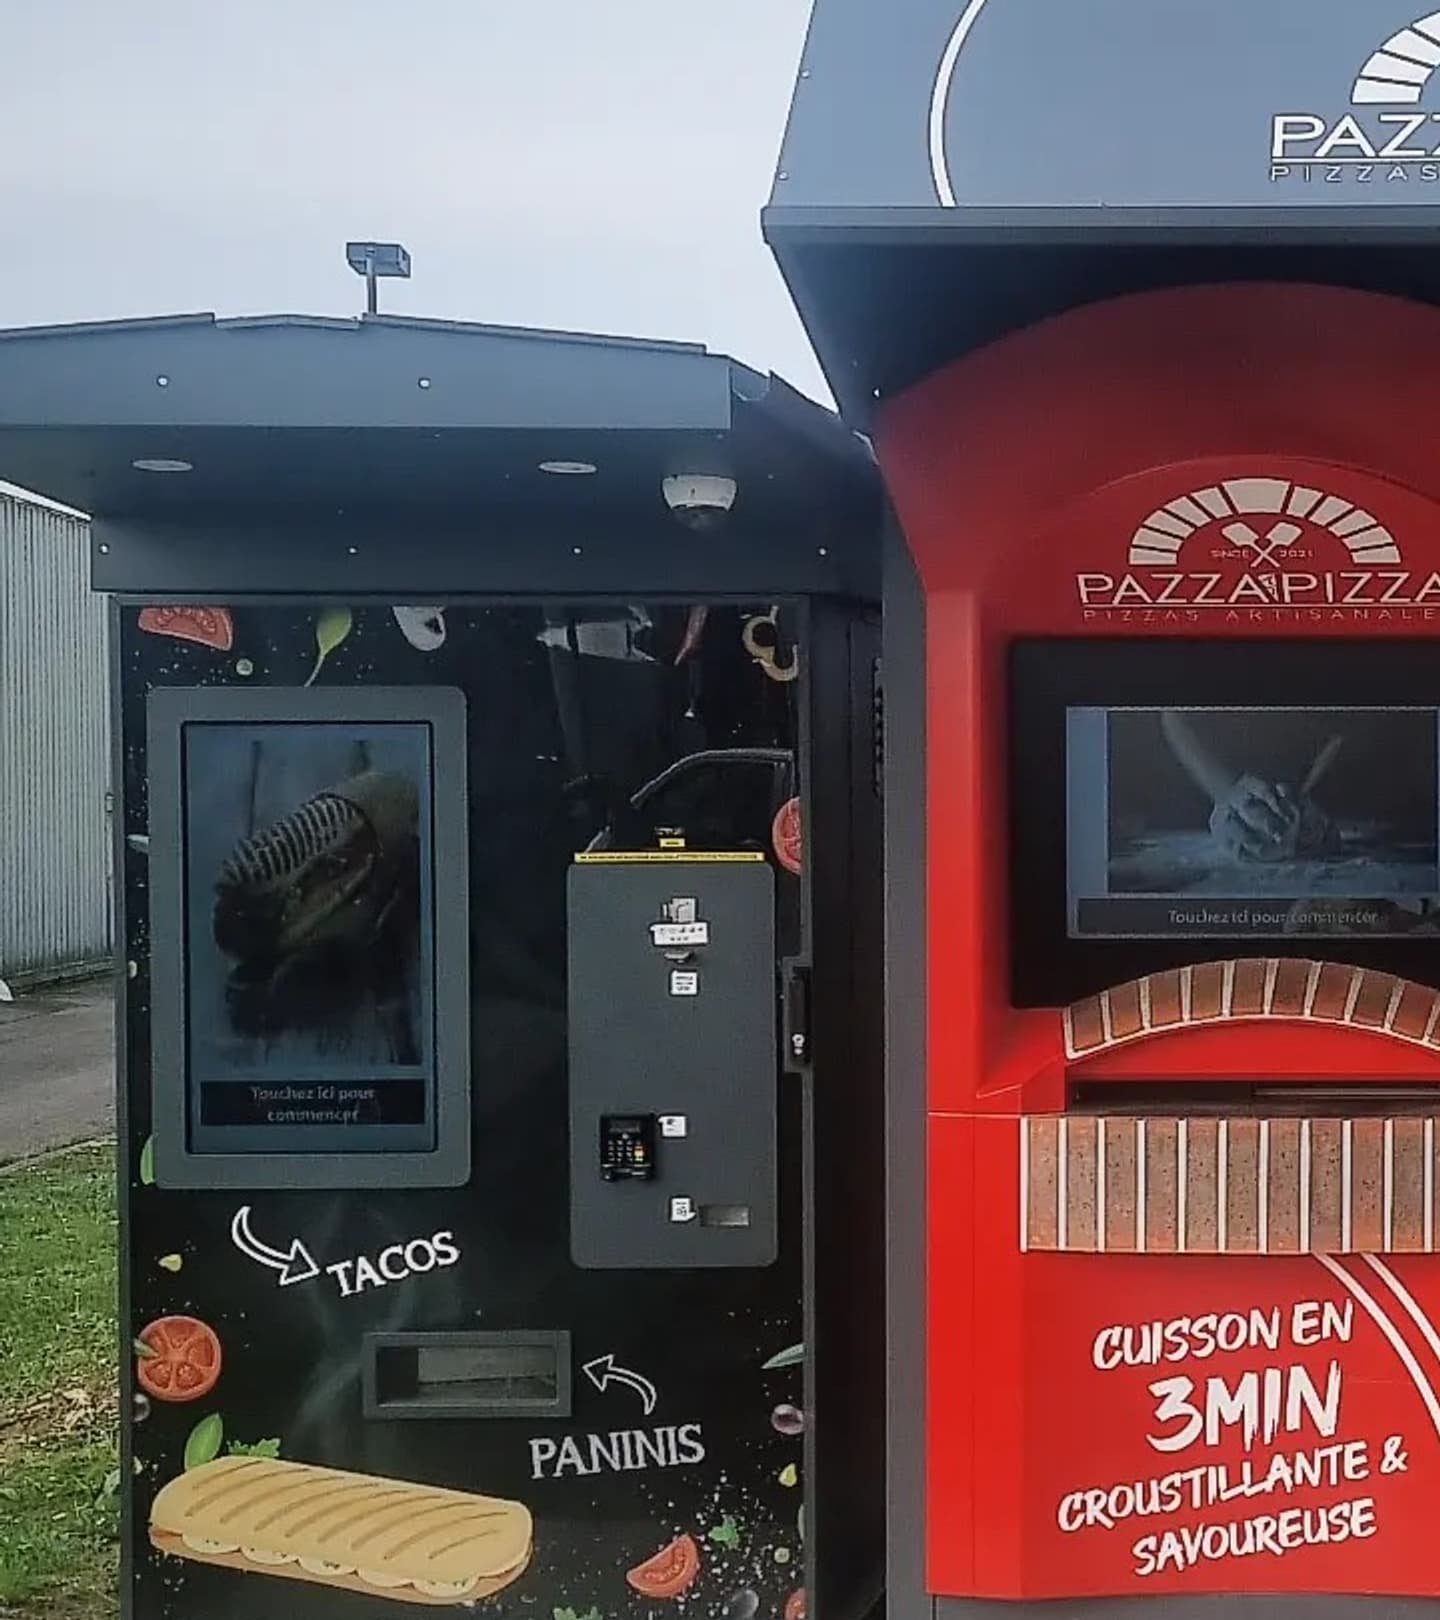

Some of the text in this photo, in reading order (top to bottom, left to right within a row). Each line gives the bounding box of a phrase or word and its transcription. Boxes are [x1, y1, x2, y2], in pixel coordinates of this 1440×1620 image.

[1270, 163, 1440, 182] PIZZAS
[1082, 609, 1200, 622] PIZZAS
[1167, 908, 1229, 924] Touchez
[251, 1085, 314, 1101] Touchez
[338, 1088, 376, 1104] pour
[267, 1107, 360, 1122] commencer
[326, 1231, 461, 1297] TACOS
[1092, 1298, 1355, 1370] CUISSON EN
[528, 1423, 706, 1480] PANINIS
[1057, 1434, 1409, 1533] CROUSTILLANTE &
[1131, 1497, 1379, 1577] SAVOUREUSE
